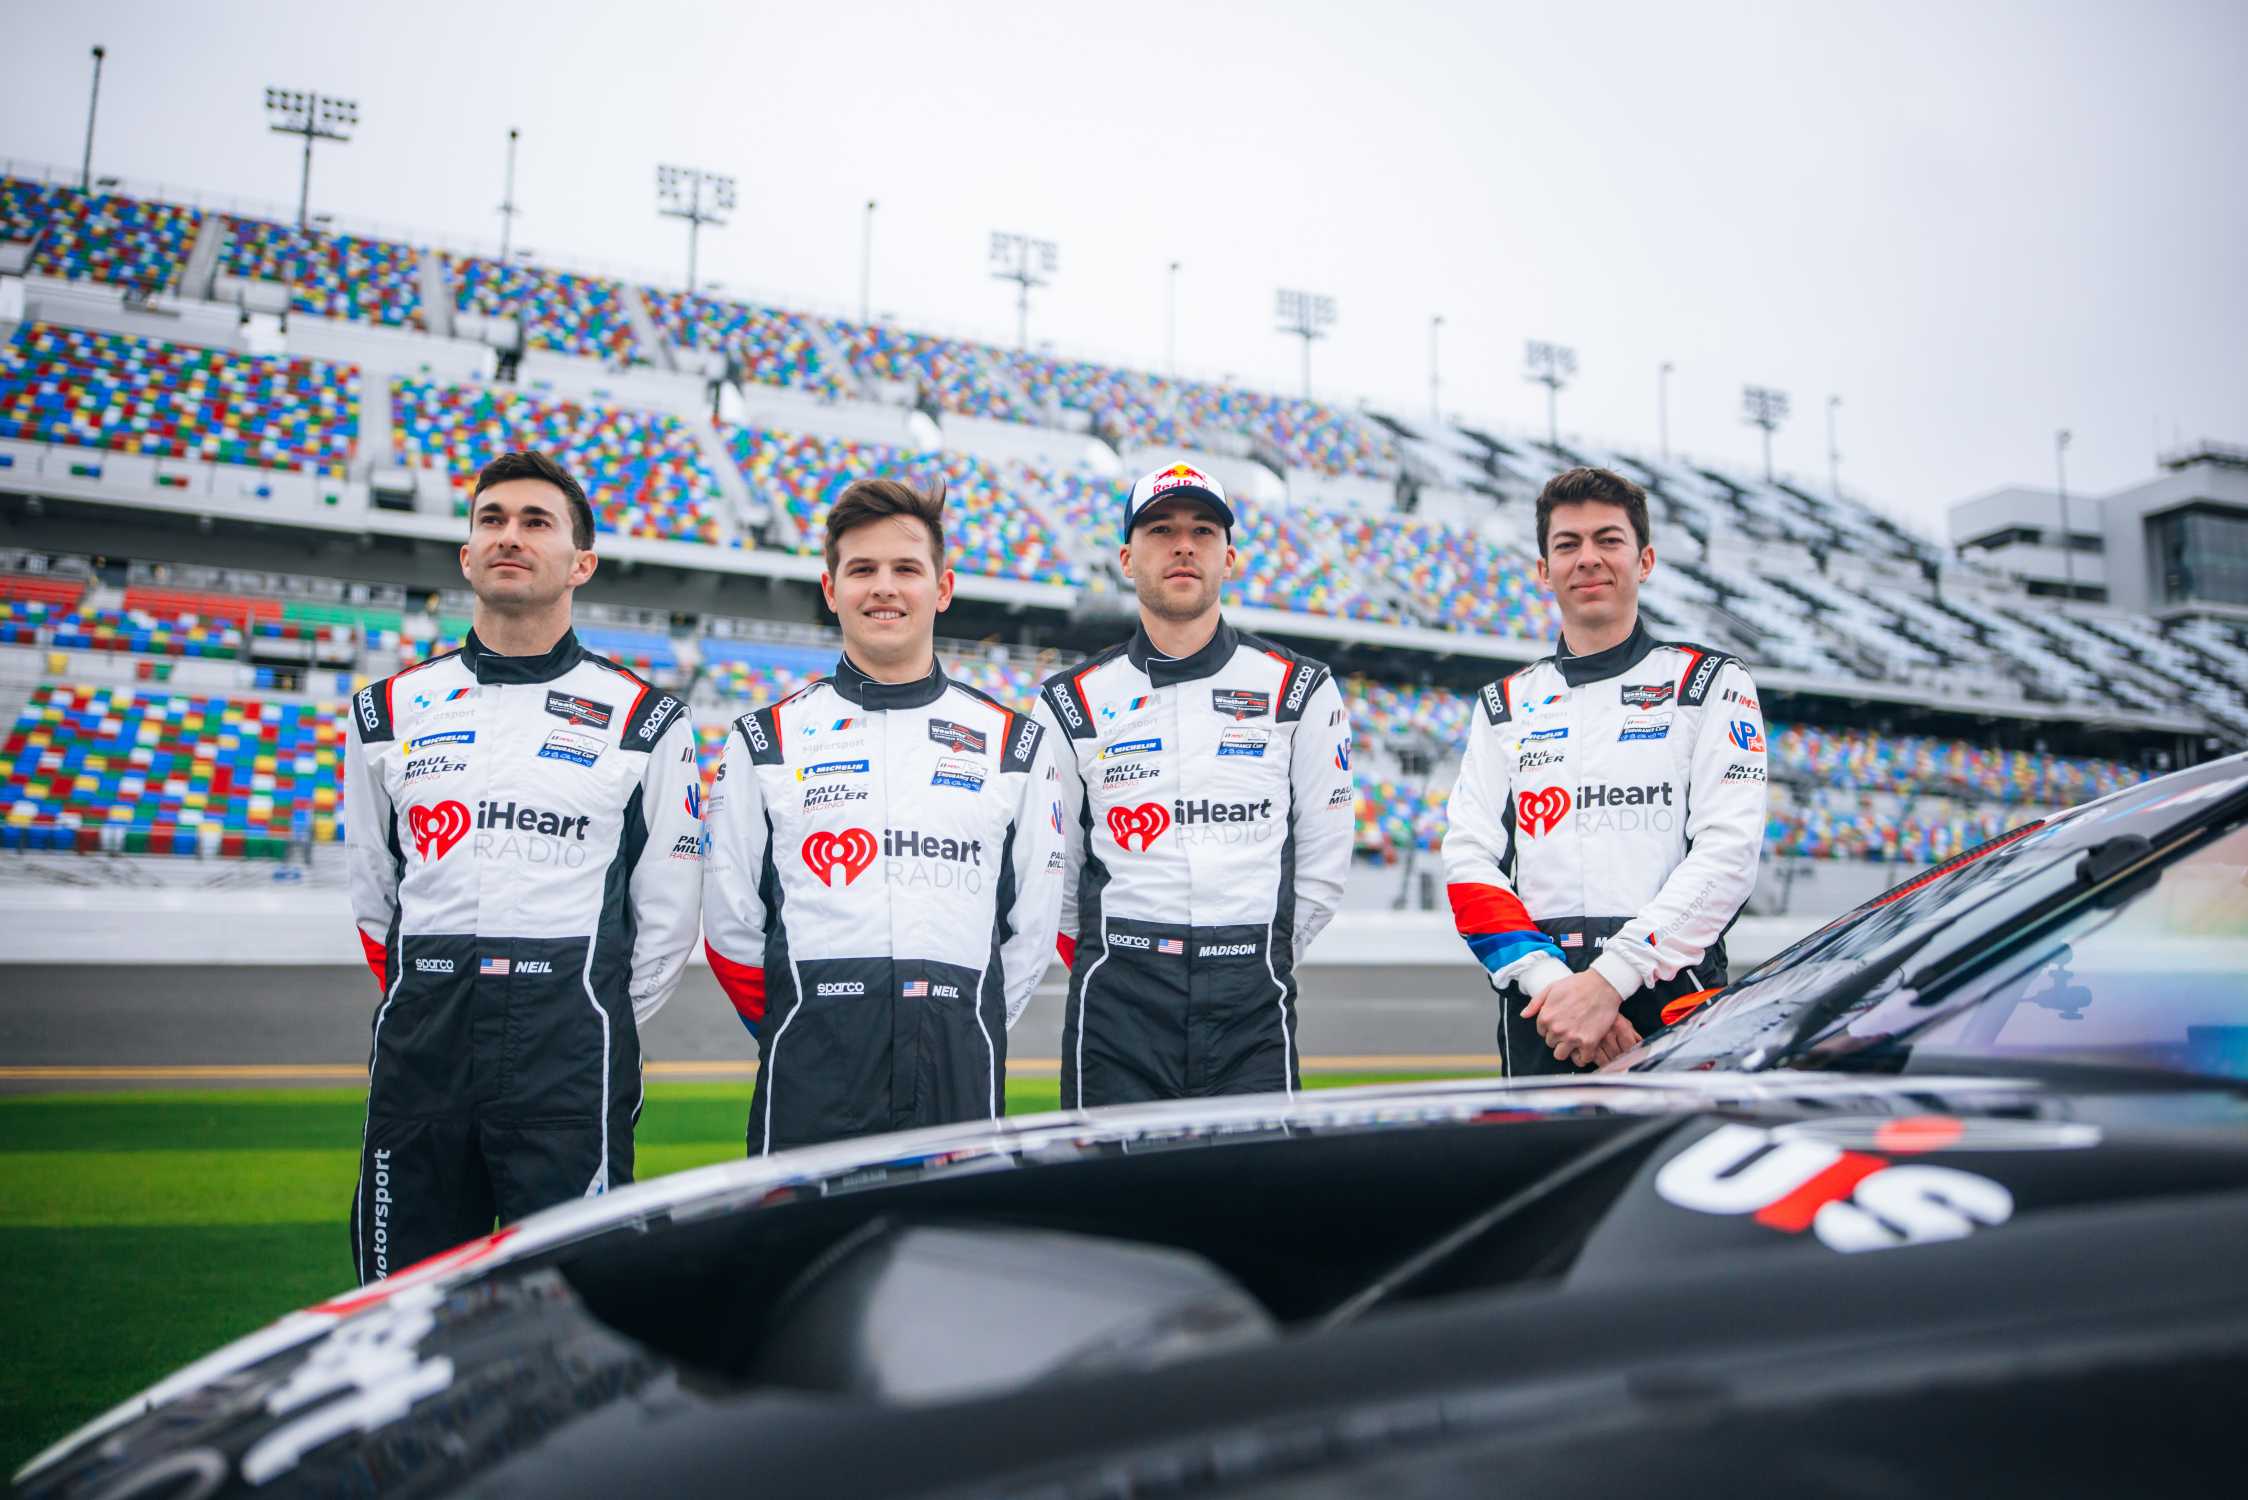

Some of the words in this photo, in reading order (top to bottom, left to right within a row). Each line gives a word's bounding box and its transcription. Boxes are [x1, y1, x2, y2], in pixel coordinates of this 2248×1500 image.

[1689, 656, 1721, 700] sparco
[1286, 665, 1316, 712] sparco
[1052, 683, 1083, 729] sparco
[1738, 695, 1760, 711] IMS
[640, 696, 677, 741] sparco
[420, 734, 470, 746] MICHELIN
[741, 713, 769, 752] sparco
[1729, 719, 1757, 750] VP
[1114, 742, 1157, 753] MICHELIN
[407, 756, 449, 771] PAUL
[816, 763, 864, 773] MICHELIN
[1105, 763, 1144, 776] PAUL
[404, 764, 467, 780] MILLER
[1103, 769, 1161, 783] MILLER
[1723, 772, 1766, 782] MILL
[806, 784, 850, 798] PAUL
[1332, 786, 1352, 796] PAU
[1575, 781, 1673, 810] iHeart
[803, 791, 869, 808] MILLER
[1174, 798, 1272, 825] iHeart
[477, 800, 591, 841] iHeart
[1575, 808, 1674, 833] RADIO
[678, 835, 701, 846] PAU
[1175, 822, 1272, 849] RADIO
[473, 832, 586, 869] RADIO
[883, 828, 982, 867] iHeart
[883, 860, 982, 895] RADIO
[1108, 932, 1150, 949] sparco
[1198, 943, 1257, 958] MADISON
[415, 957, 455, 973] sparco
[514, 960, 553, 974] NEIL
[816, 982, 865, 996] sparco
[931, 985, 960, 999] NEIL
